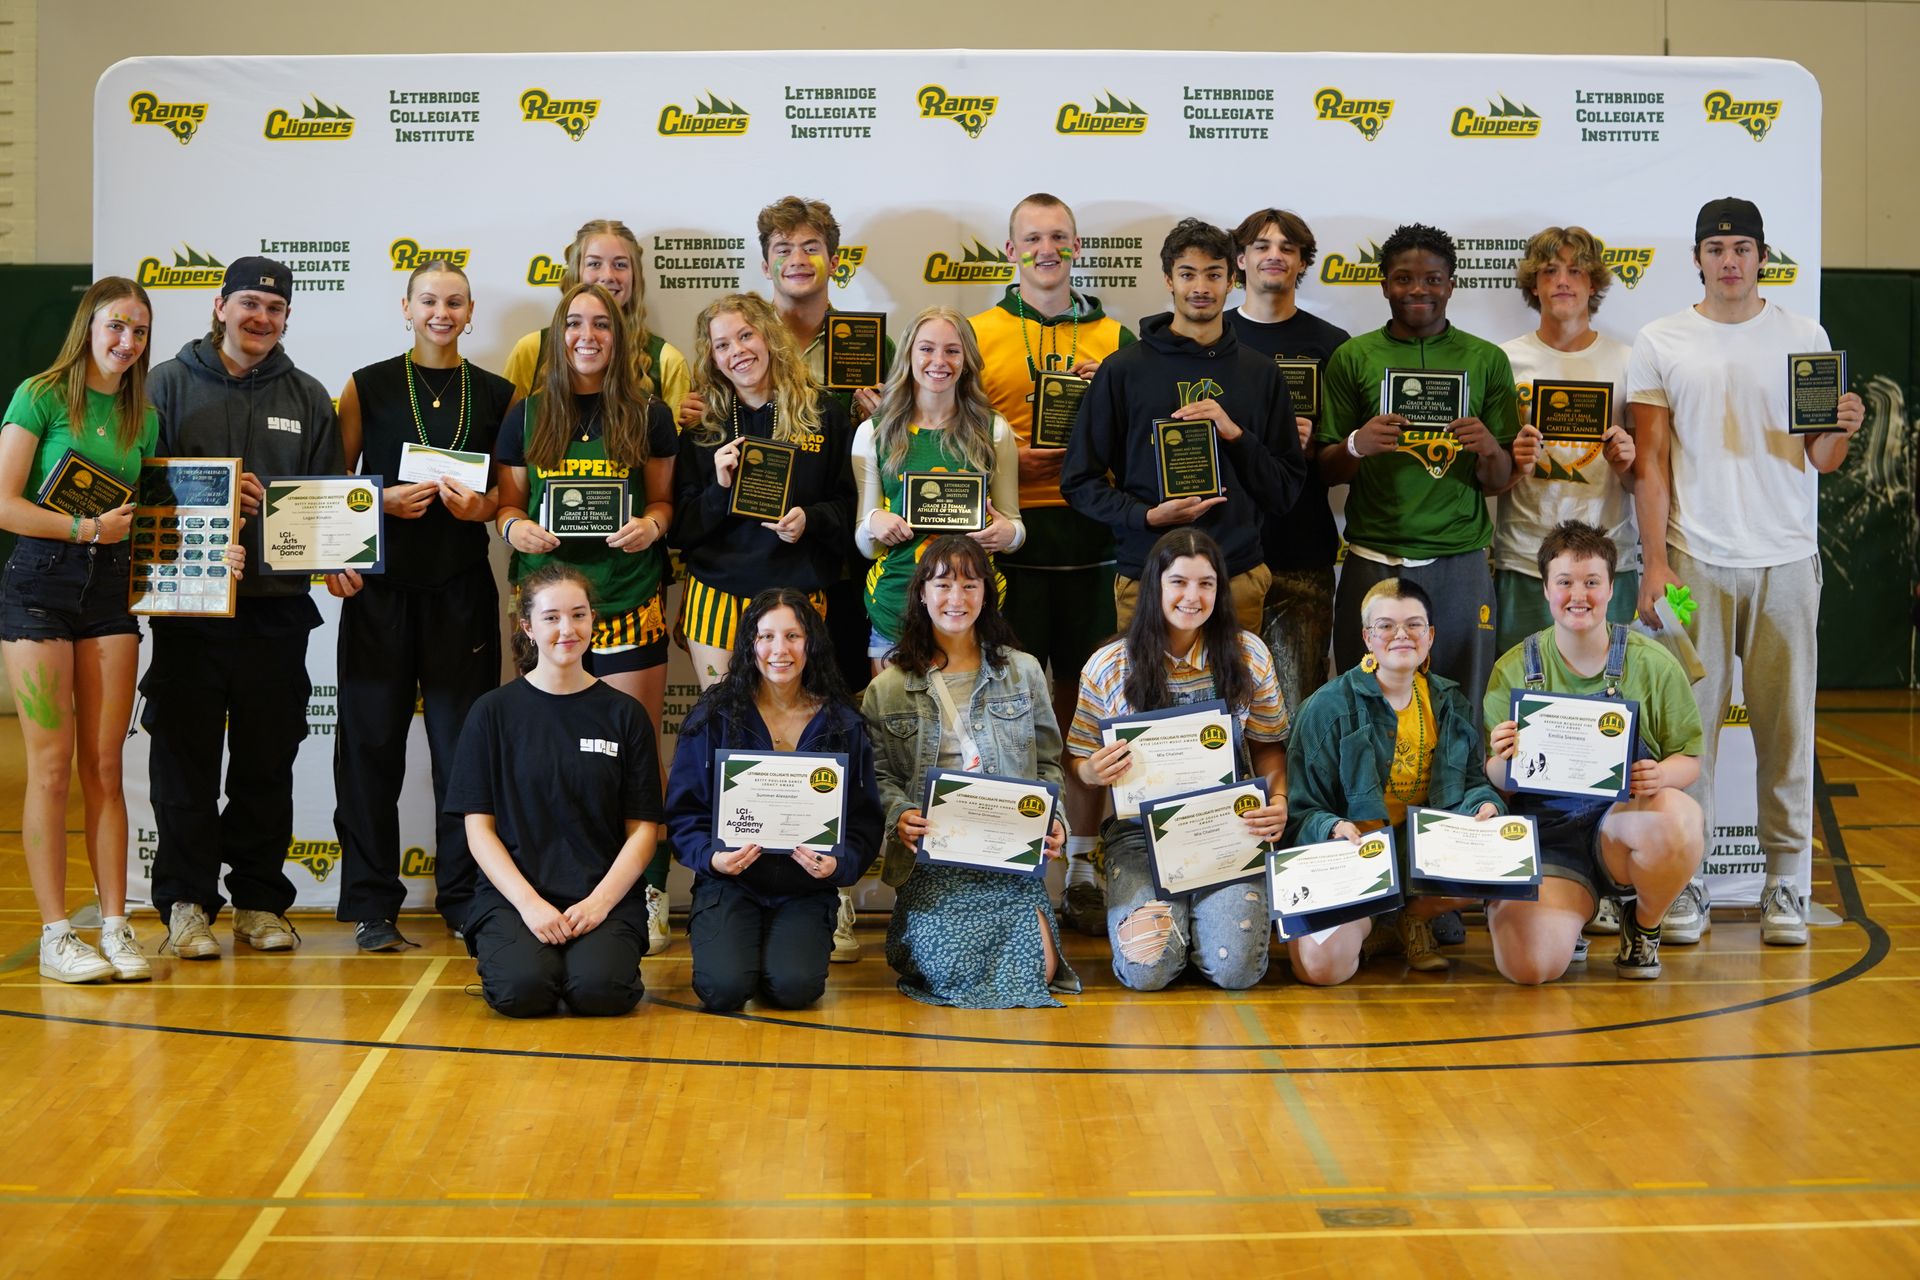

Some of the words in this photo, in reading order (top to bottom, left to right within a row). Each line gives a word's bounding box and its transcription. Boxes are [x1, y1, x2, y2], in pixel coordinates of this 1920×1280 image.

[390, 90, 480, 104] LETHBRIDGE
[785, 86, 877, 100] LETHBRIDGE
[1183, 86, 1274, 100] LETHBRIDGE
[1575, 89, 1665, 103] LETHBRIDGE
[130, 92, 205, 122] Rams
[521, 88, 597, 119] Rams
[918, 86, 996, 116] Rams
[1315, 88, 1391, 118] Rams
[1704, 91, 1779, 120] Rams
[390, 109, 480, 123] COLLEGIATE
[785, 105, 877, 119] COLLEGIATE
[1056, 104, 1146, 133] Clippers
[1184, 105, 1273, 120] COLLEGIATE
[1576, 109, 1665, 123] COLLEGIATE
[265, 109, 352, 139] Clippers
[657, 106, 748, 134] Clippers
[1451, 107, 1540, 136] Clippers
[396, 128, 475, 142] INSTITUTE
[791, 124, 871, 139] INSTITUTE
[1189, 124, 1269, 139] INSTITUTE
[1581, 128, 1660, 142] INSTITUTE
[260, 238, 350, 252] LETHBRIDGE
[654, 236, 745, 250] LETHBRIDGE
[1081, 237, 1143, 249] HBRIDGE
[654, 255, 745, 270] COLLEGIATE
[1601, 247, 1652, 264] ams
[924, 251, 1015, 283] Clippers
[1072, 257, 1143, 269] LLEGIATE
[1320, 252, 1384, 285] Clipp
[137, 257, 224, 287] Clippers
[292, 279, 345, 291] TITUTE
[659, 274, 740, 289] INSTITUTE
[801, 443, 821, 453] 023
[947, 516, 969, 524] SMITH
[726, 820, 763, 828] Academy
[735, 826, 760, 834] Dance
